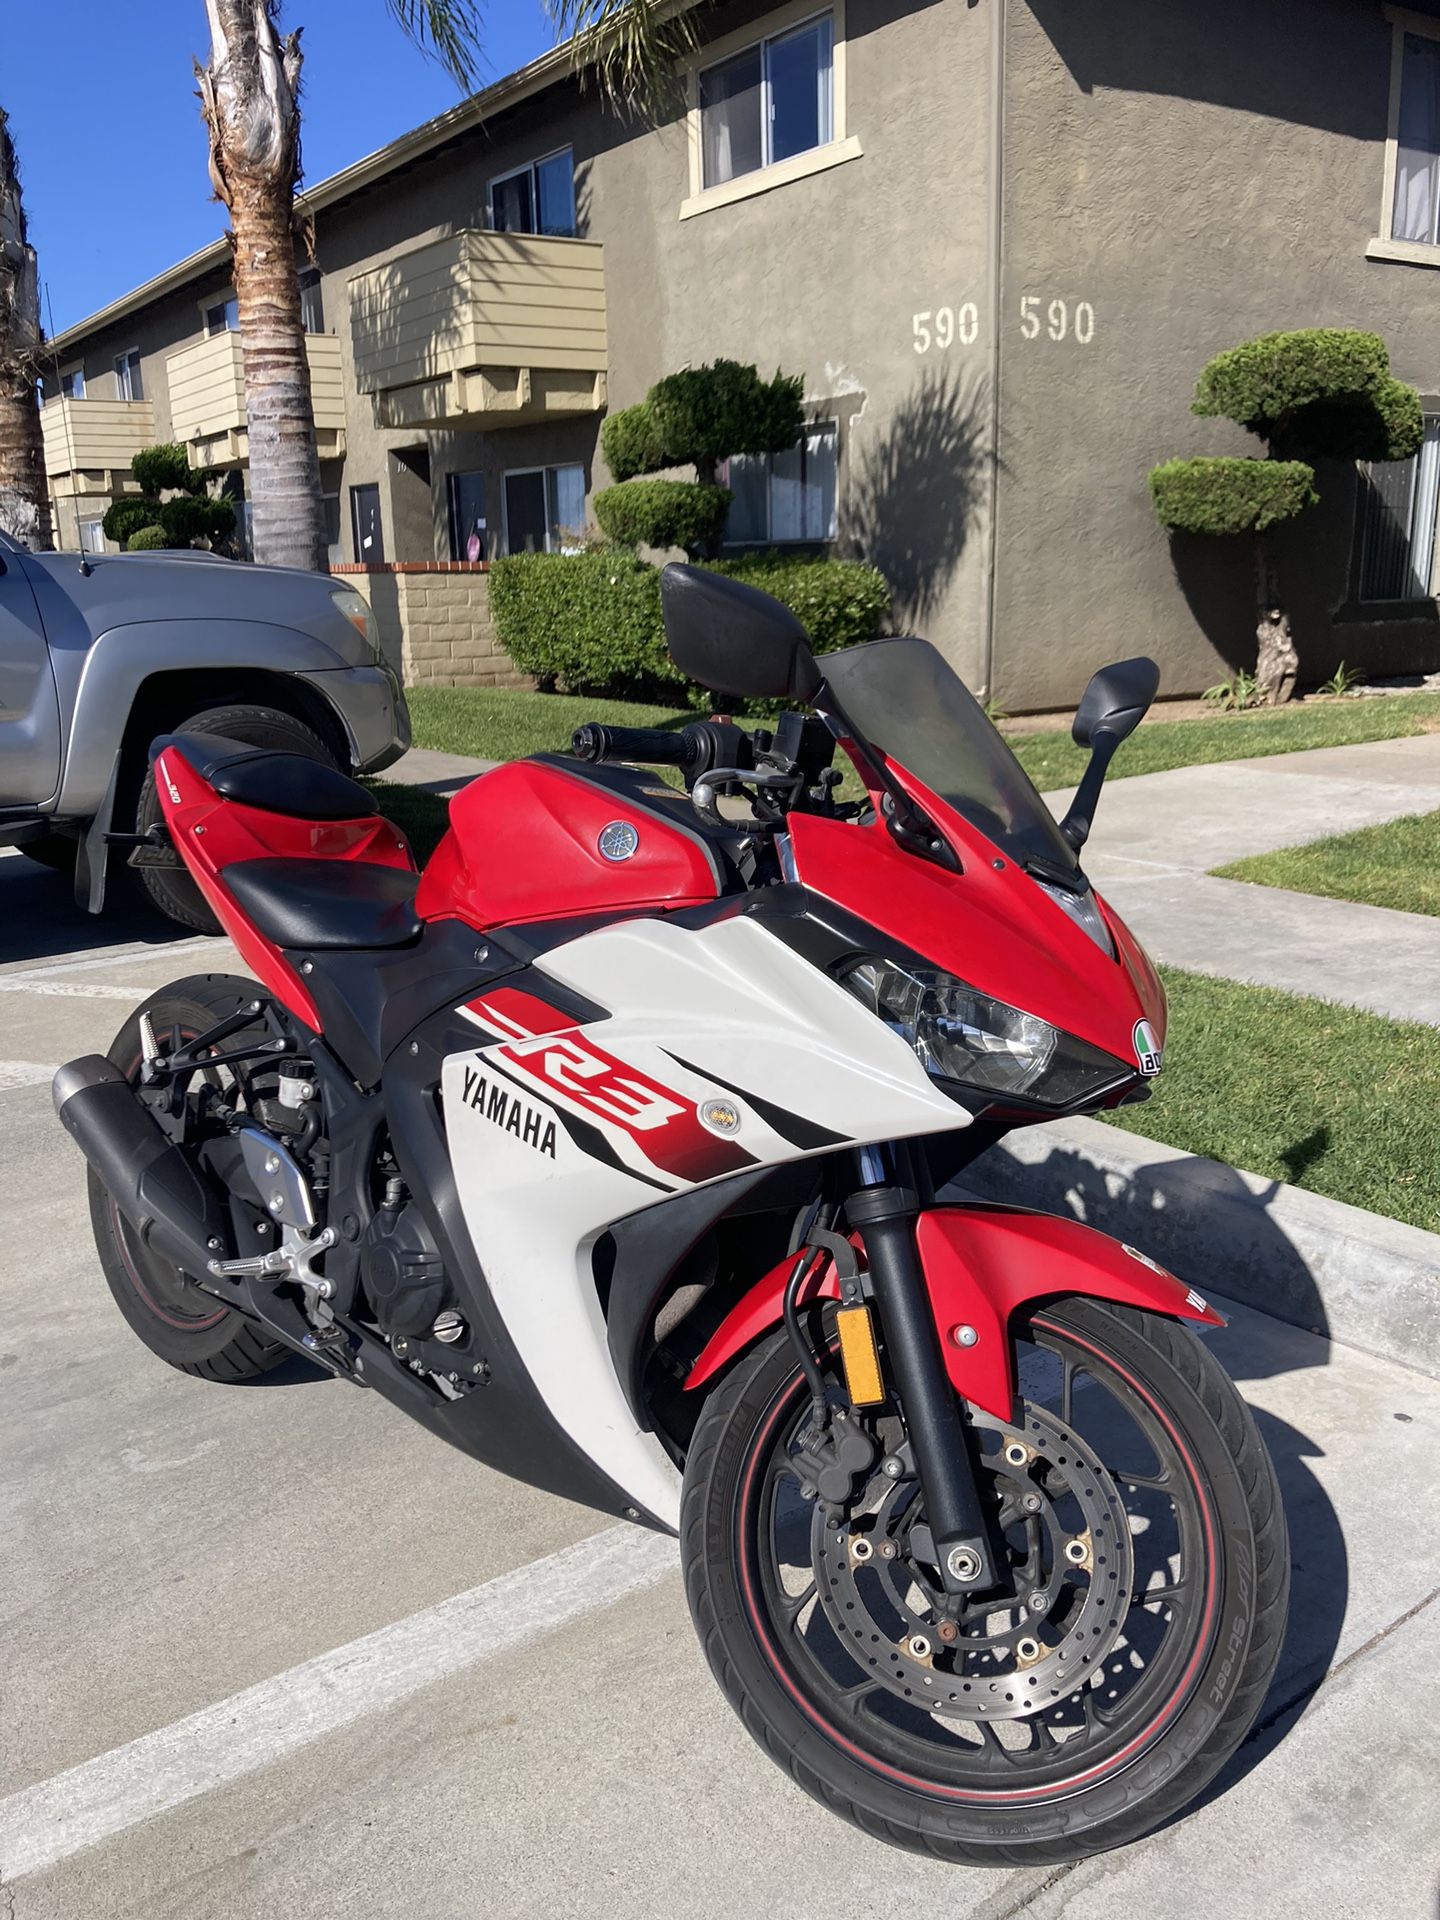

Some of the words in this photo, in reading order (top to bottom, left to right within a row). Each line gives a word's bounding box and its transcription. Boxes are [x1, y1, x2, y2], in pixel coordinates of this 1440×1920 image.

[912, 302, 978, 354] 590
[1020, 296, 1094, 344] 590
[462, 1065, 556, 1160] YAMAHA
[504, 1036, 688, 1131] R3
[1210, 1616, 1246, 1702] Street
